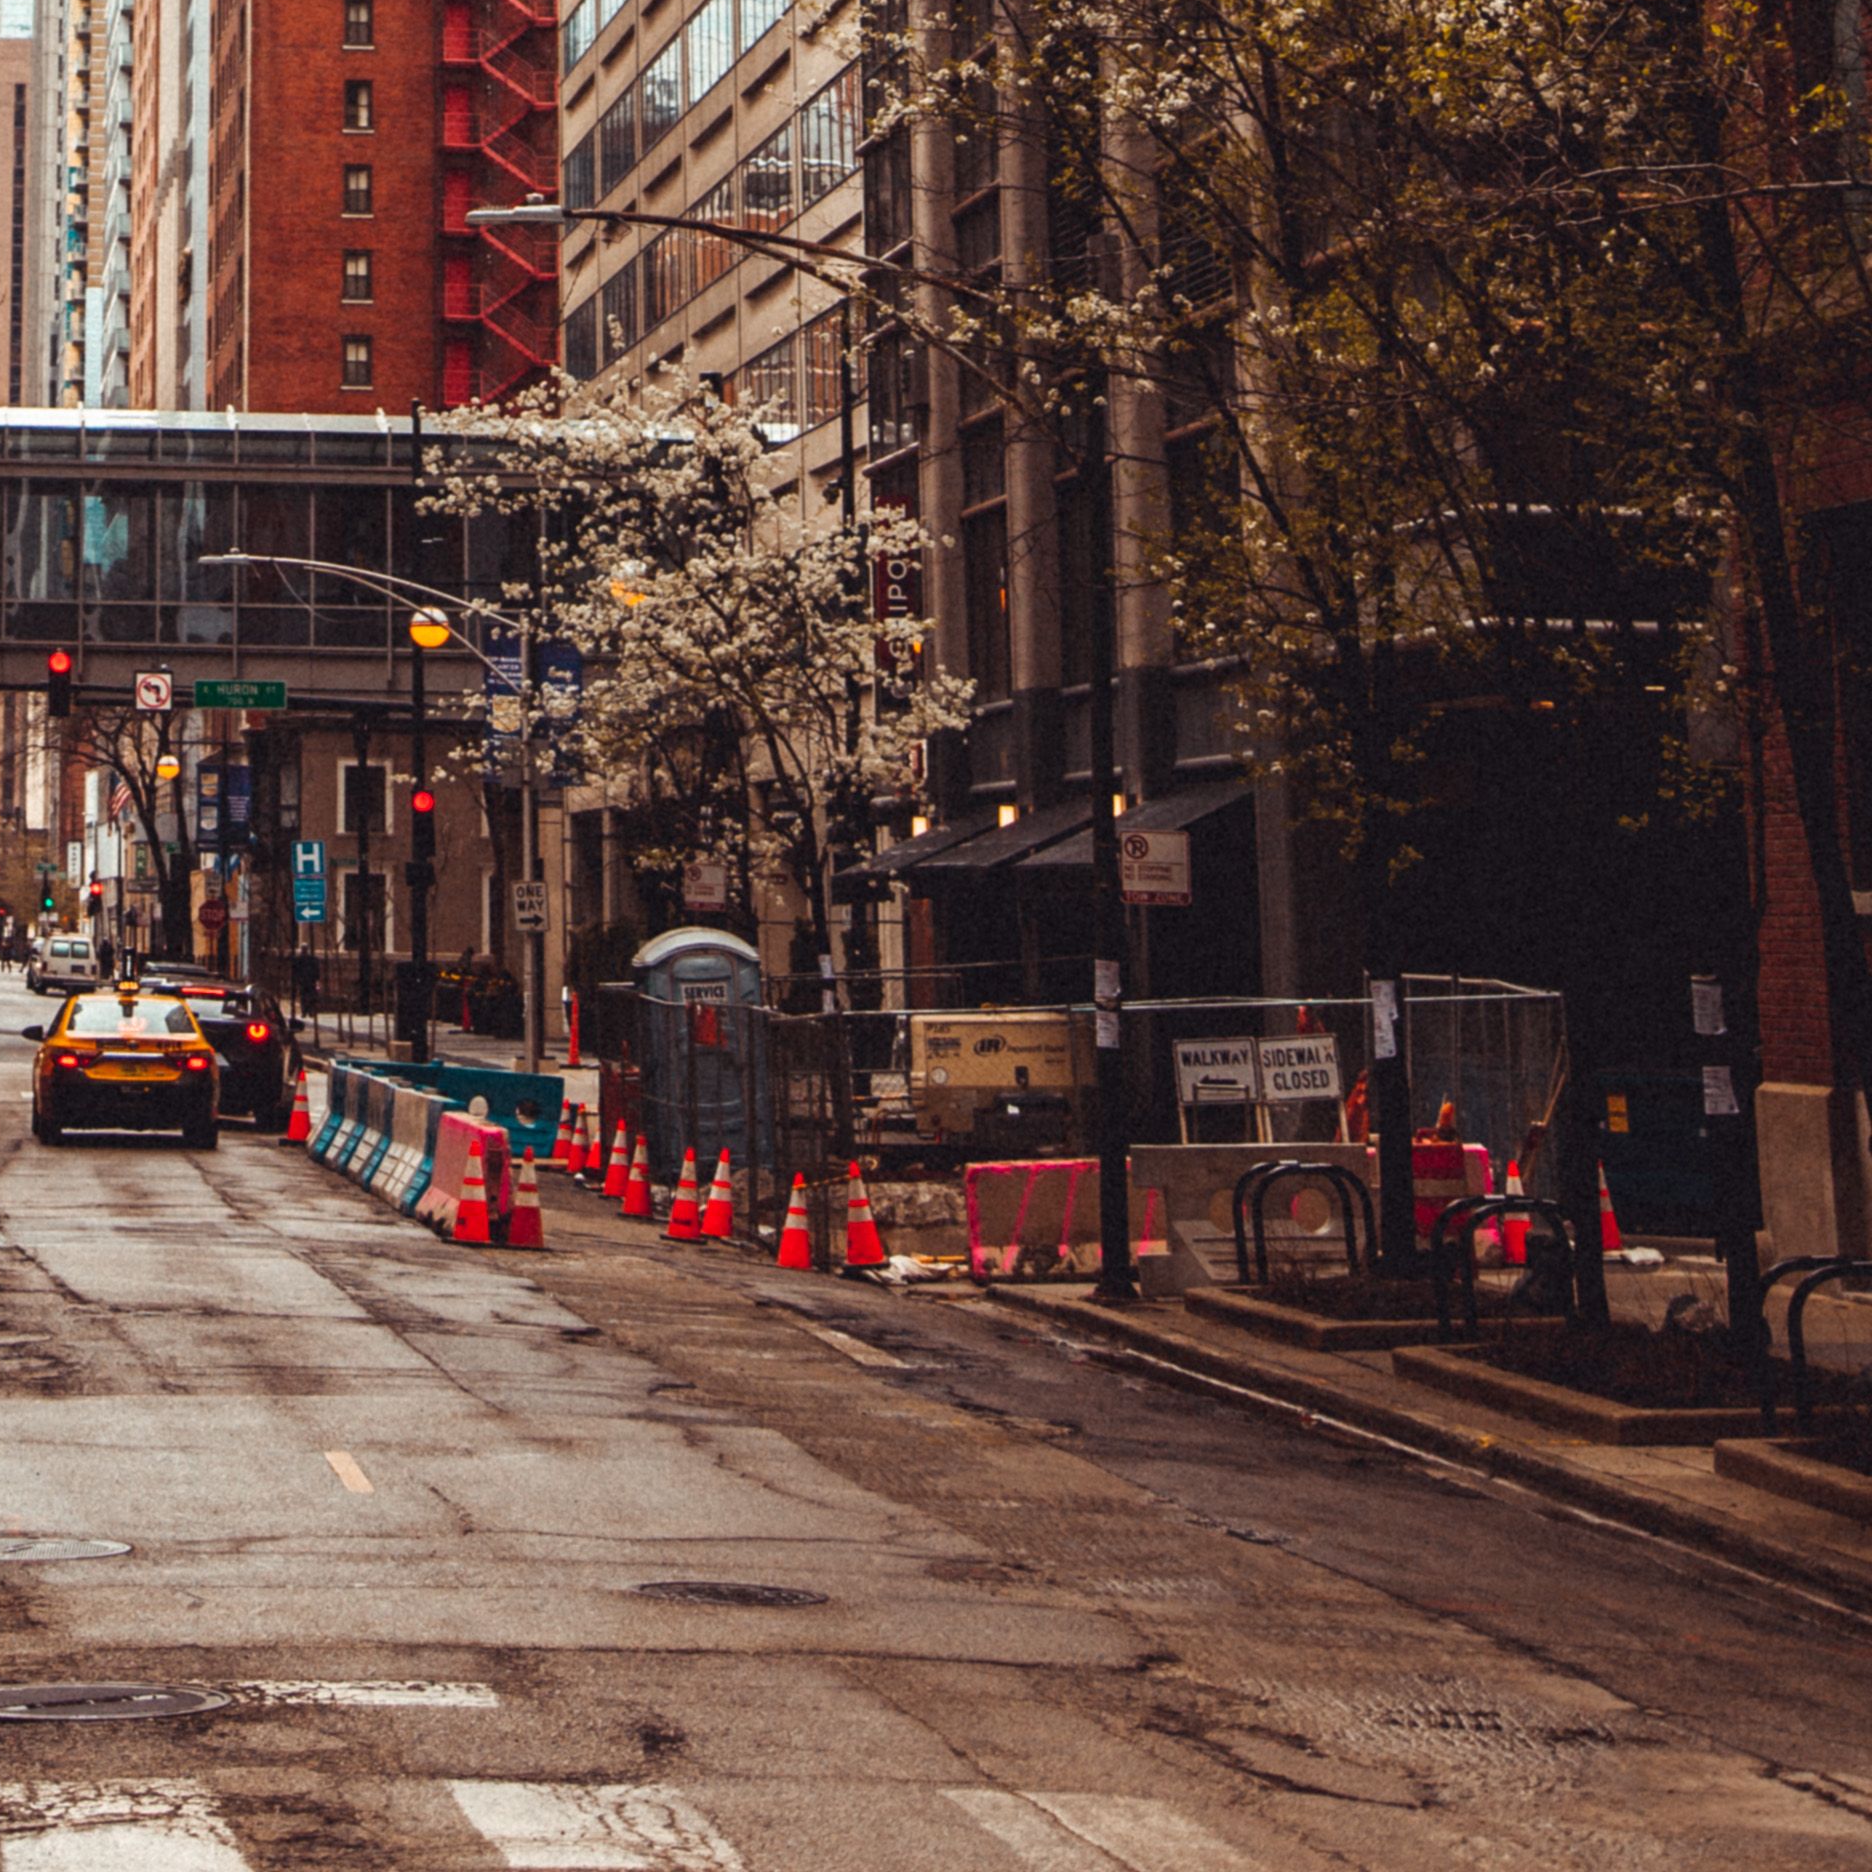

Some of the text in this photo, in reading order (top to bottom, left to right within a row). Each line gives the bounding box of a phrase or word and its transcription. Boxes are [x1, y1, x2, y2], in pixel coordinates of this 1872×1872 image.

[216, 684, 259, 695] HURON
[296, 843, 320, 873] H
[516, 886, 544, 897] ONE
[516, 899, 545, 912] WAY
[200, 908, 225, 921] STOP
[684, 985, 725, 999] SERVICE
[1181, 1049, 1249, 1067] WALKWAY
[1273, 1069, 1330, 1091] CLOSED
